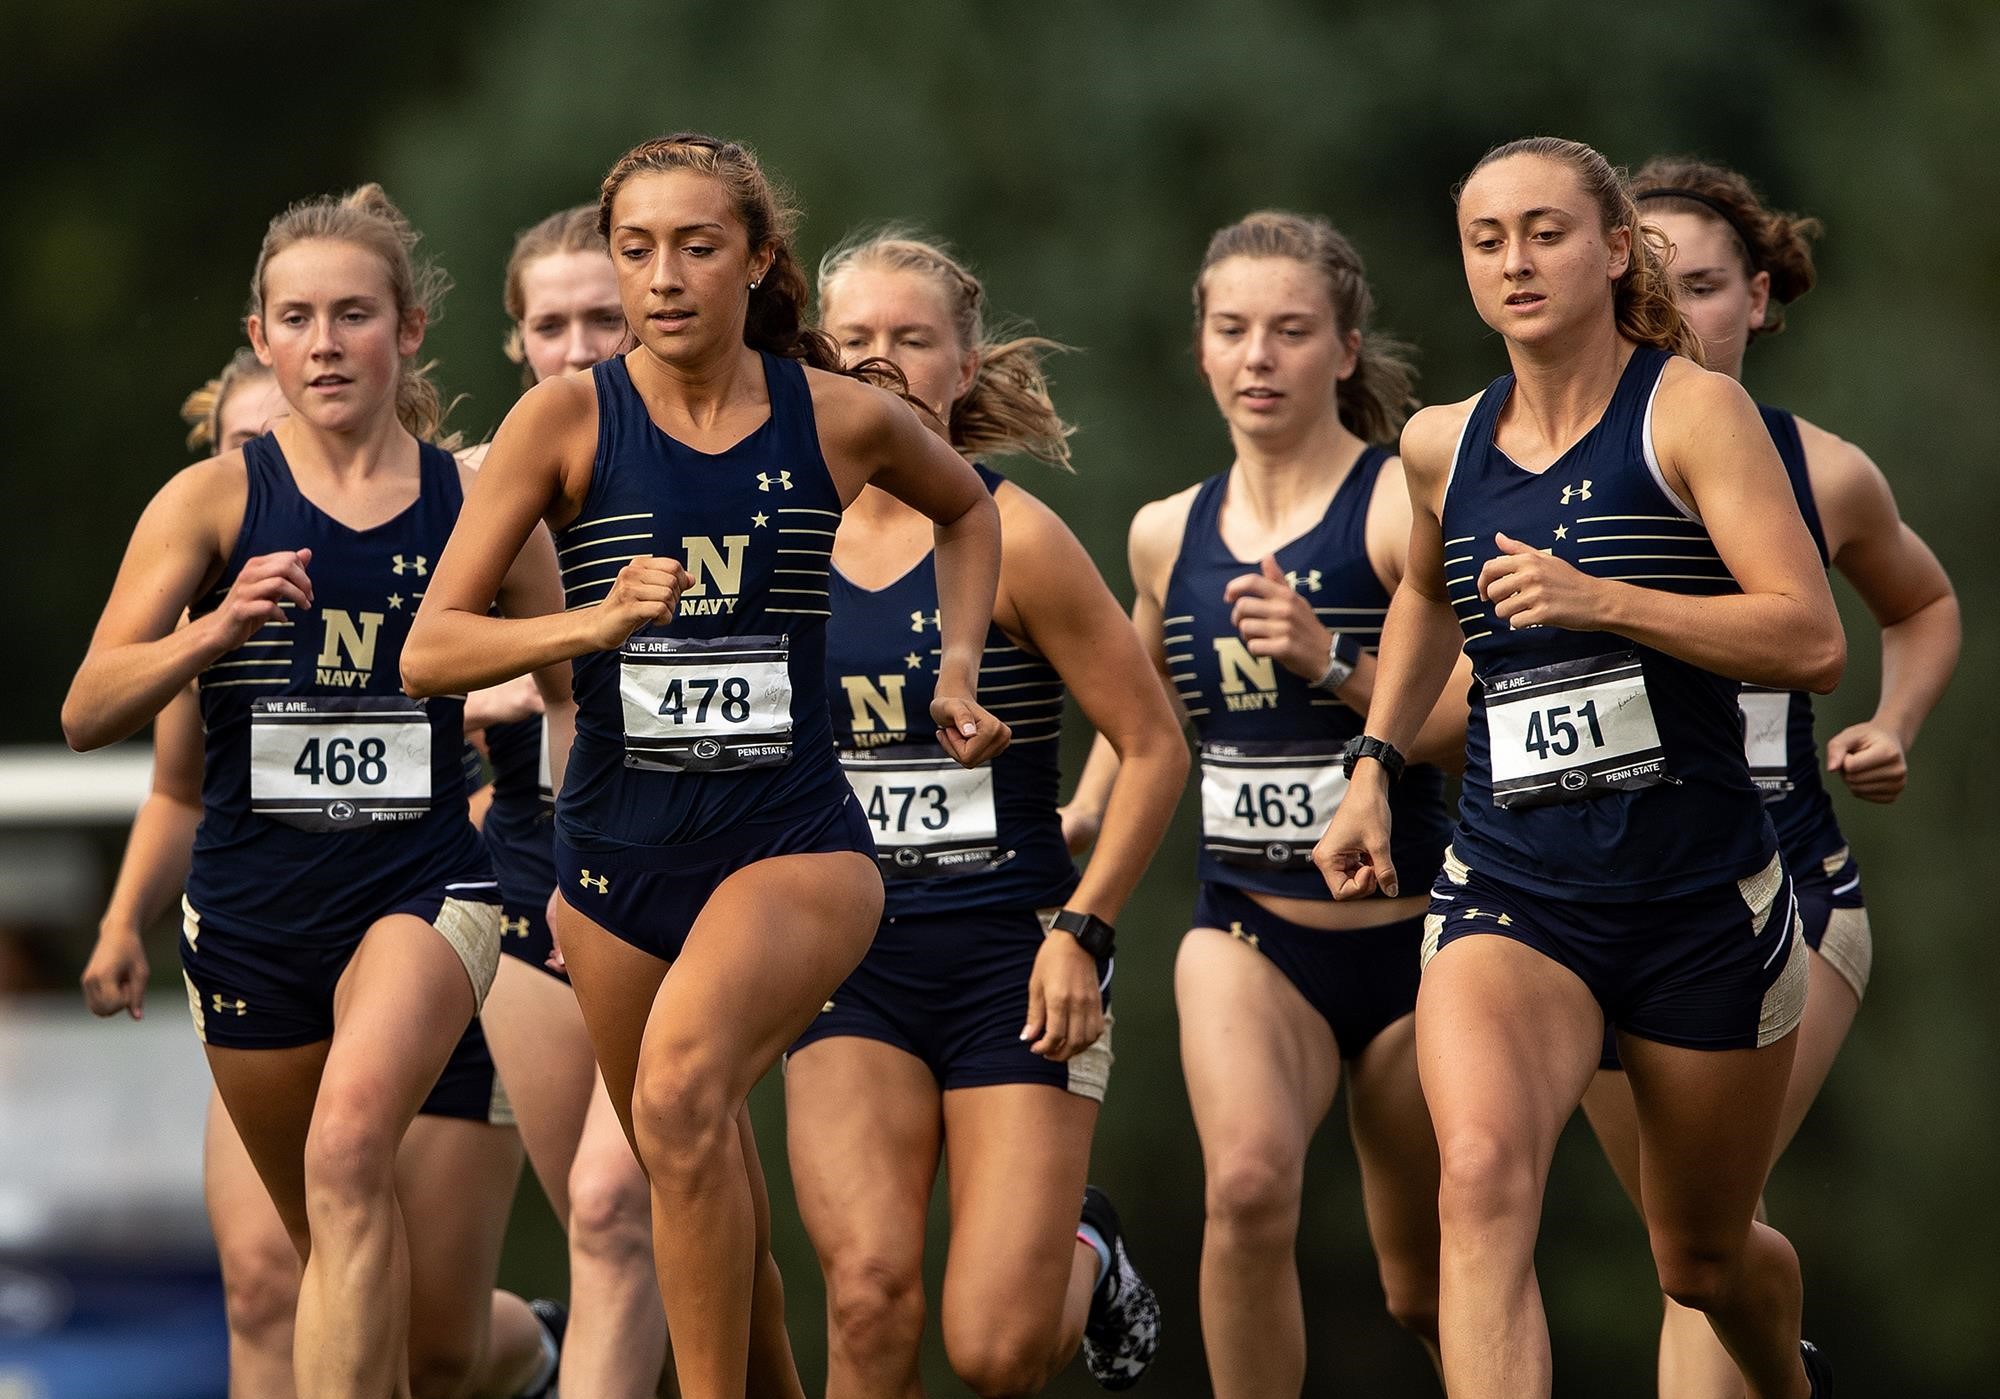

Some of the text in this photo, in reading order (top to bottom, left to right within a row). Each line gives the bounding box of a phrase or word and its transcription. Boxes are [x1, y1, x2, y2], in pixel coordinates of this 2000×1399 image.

[680, 535, 750, 597] N
[679, 598, 738, 617] NAVY
[317, 608, 384, 670] N
[630, 642, 646, 652] WE
[315, 669, 372, 688] NAVY
[1213, 636, 1278, 693] N
[658, 677, 750, 725] 478
[1224, 691, 1279, 712] NAVY
[1495, 680, 1508, 691] WE
[266, 701, 284, 712] WE
[840, 674, 907, 731] N
[1525, 699, 1605, 760] 451
[294, 737, 388, 785] 468
[737, 745, 787, 758] PENN STATE
[1605, 762, 1660, 783] PENN STATE
[371, 812, 397, 821] PENN
[868, 784, 950, 832] 473
[1234, 783, 1315, 828] 463
